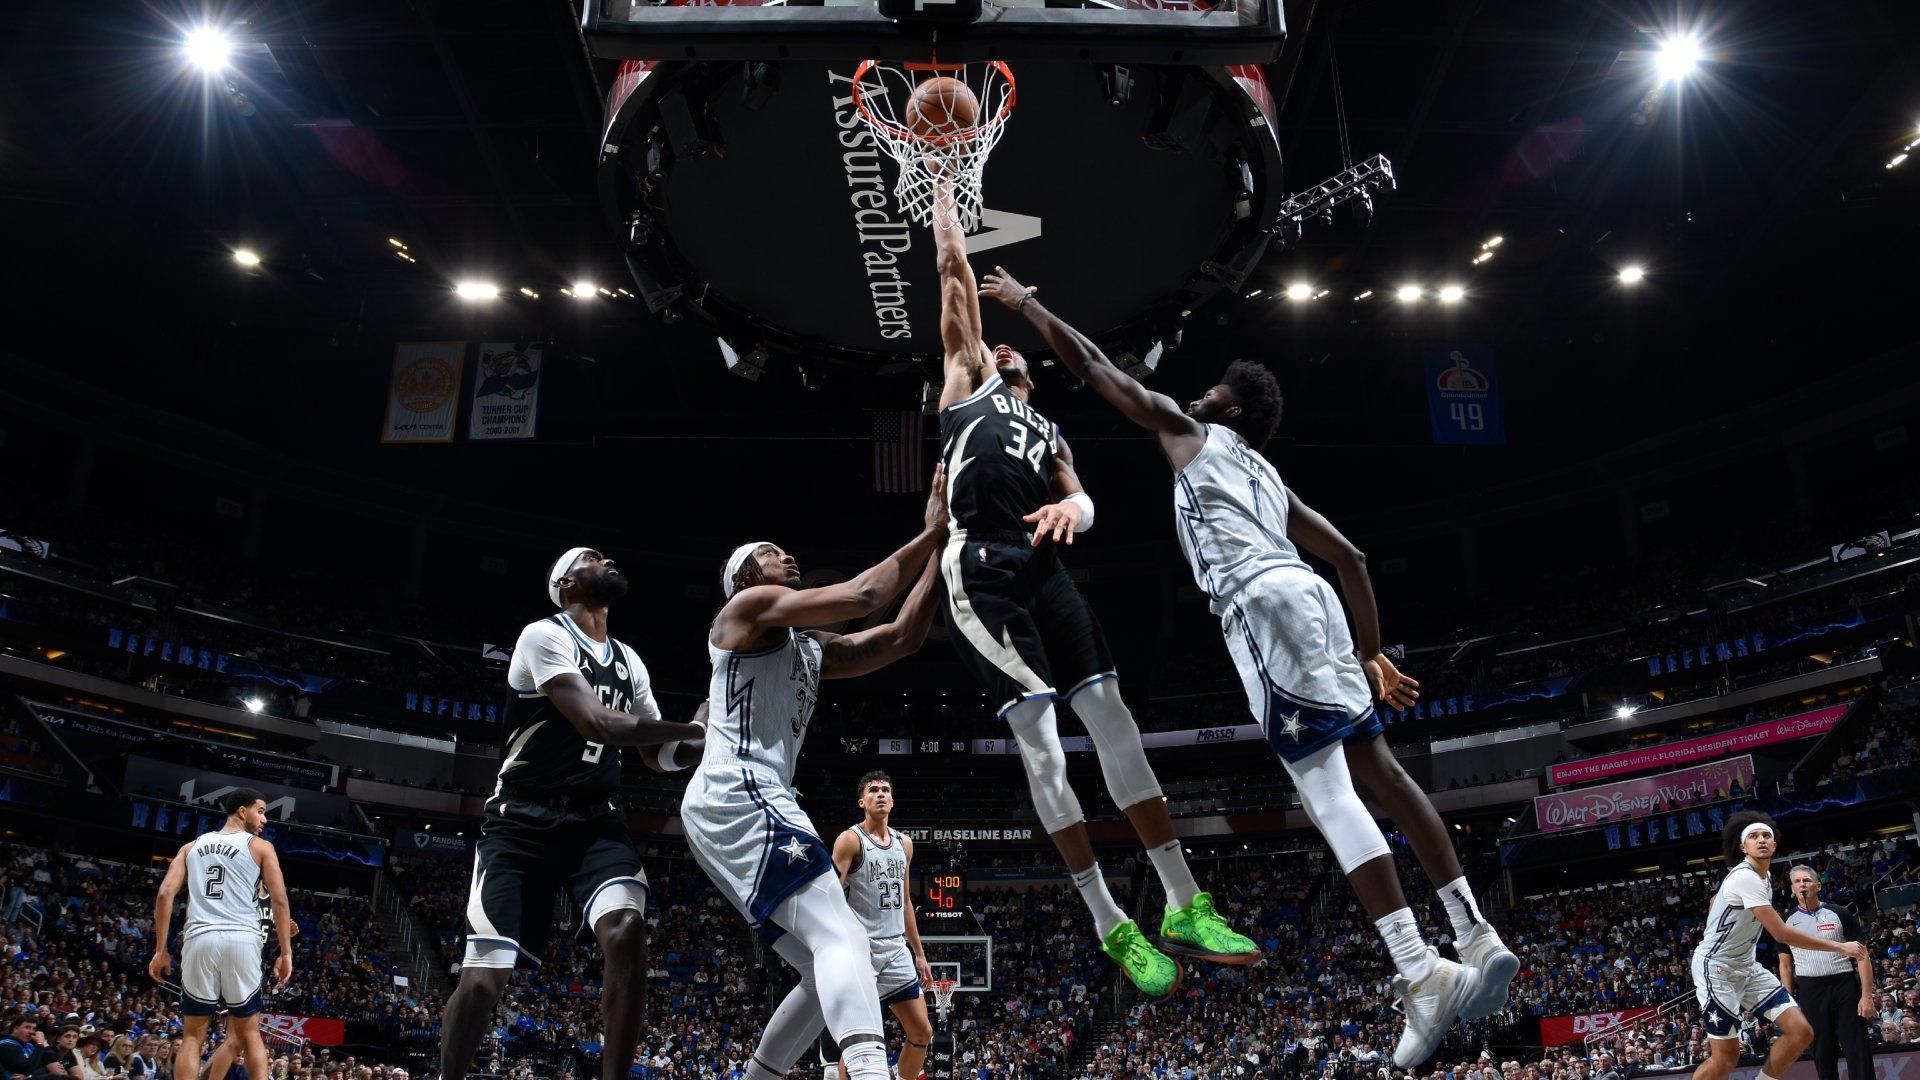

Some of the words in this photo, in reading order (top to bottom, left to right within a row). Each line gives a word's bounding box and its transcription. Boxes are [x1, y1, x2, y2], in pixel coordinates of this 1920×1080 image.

[828, 70, 912, 339] AssuredPartners
[482, 405, 512, 414] TURNER
[513, 404, 529, 414] CUP
[482, 415, 527, 424] CHAMPIONS
[1450, 402, 1484, 431] 49
[1005, 420, 1047, 474] 34
[1247, 475, 1263, 520] 1
[405, 691, 498, 723] DEFENS
[593, 685, 633, 714] CKS
[1196, 727, 1236, 741] MASSEY
[890, 741, 901, 752] 65
[920, 741, 939, 752] 4:00
[1556, 768, 1583, 779] ENJOY
[1584, 764, 1600, 774] THE
[1601, 759, 1629, 771] MAGIC
[1630, 755, 1650, 766] WITH
[1659, 747, 1696, 760] FLORIDA
[1697, 738, 1738, 753] RESIDENT
[1739, 730, 1770, 743] TICKET
[252, 757, 286, 770] Movement
[1657, 779, 1709, 802] World
[431, 836, 466, 848] FANDUEL
[904, 829, 929, 840] GHT
[934, 829, 1000, 840] BASELINE
[1003, 829, 1032, 840] BAR
[197, 843, 241, 860] HOUSTAN
[204, 864, 225, 900] 2
[935, 876, 960, 888] 4:00
[879, 882, 902, 910] 23
[930, 888, 954, 909] 4.0
[936, 911, 963, 919] TISSOT
[260, 1013, 310, 1035] DEX
[1573, 1011, 1625, 1034] DEX
